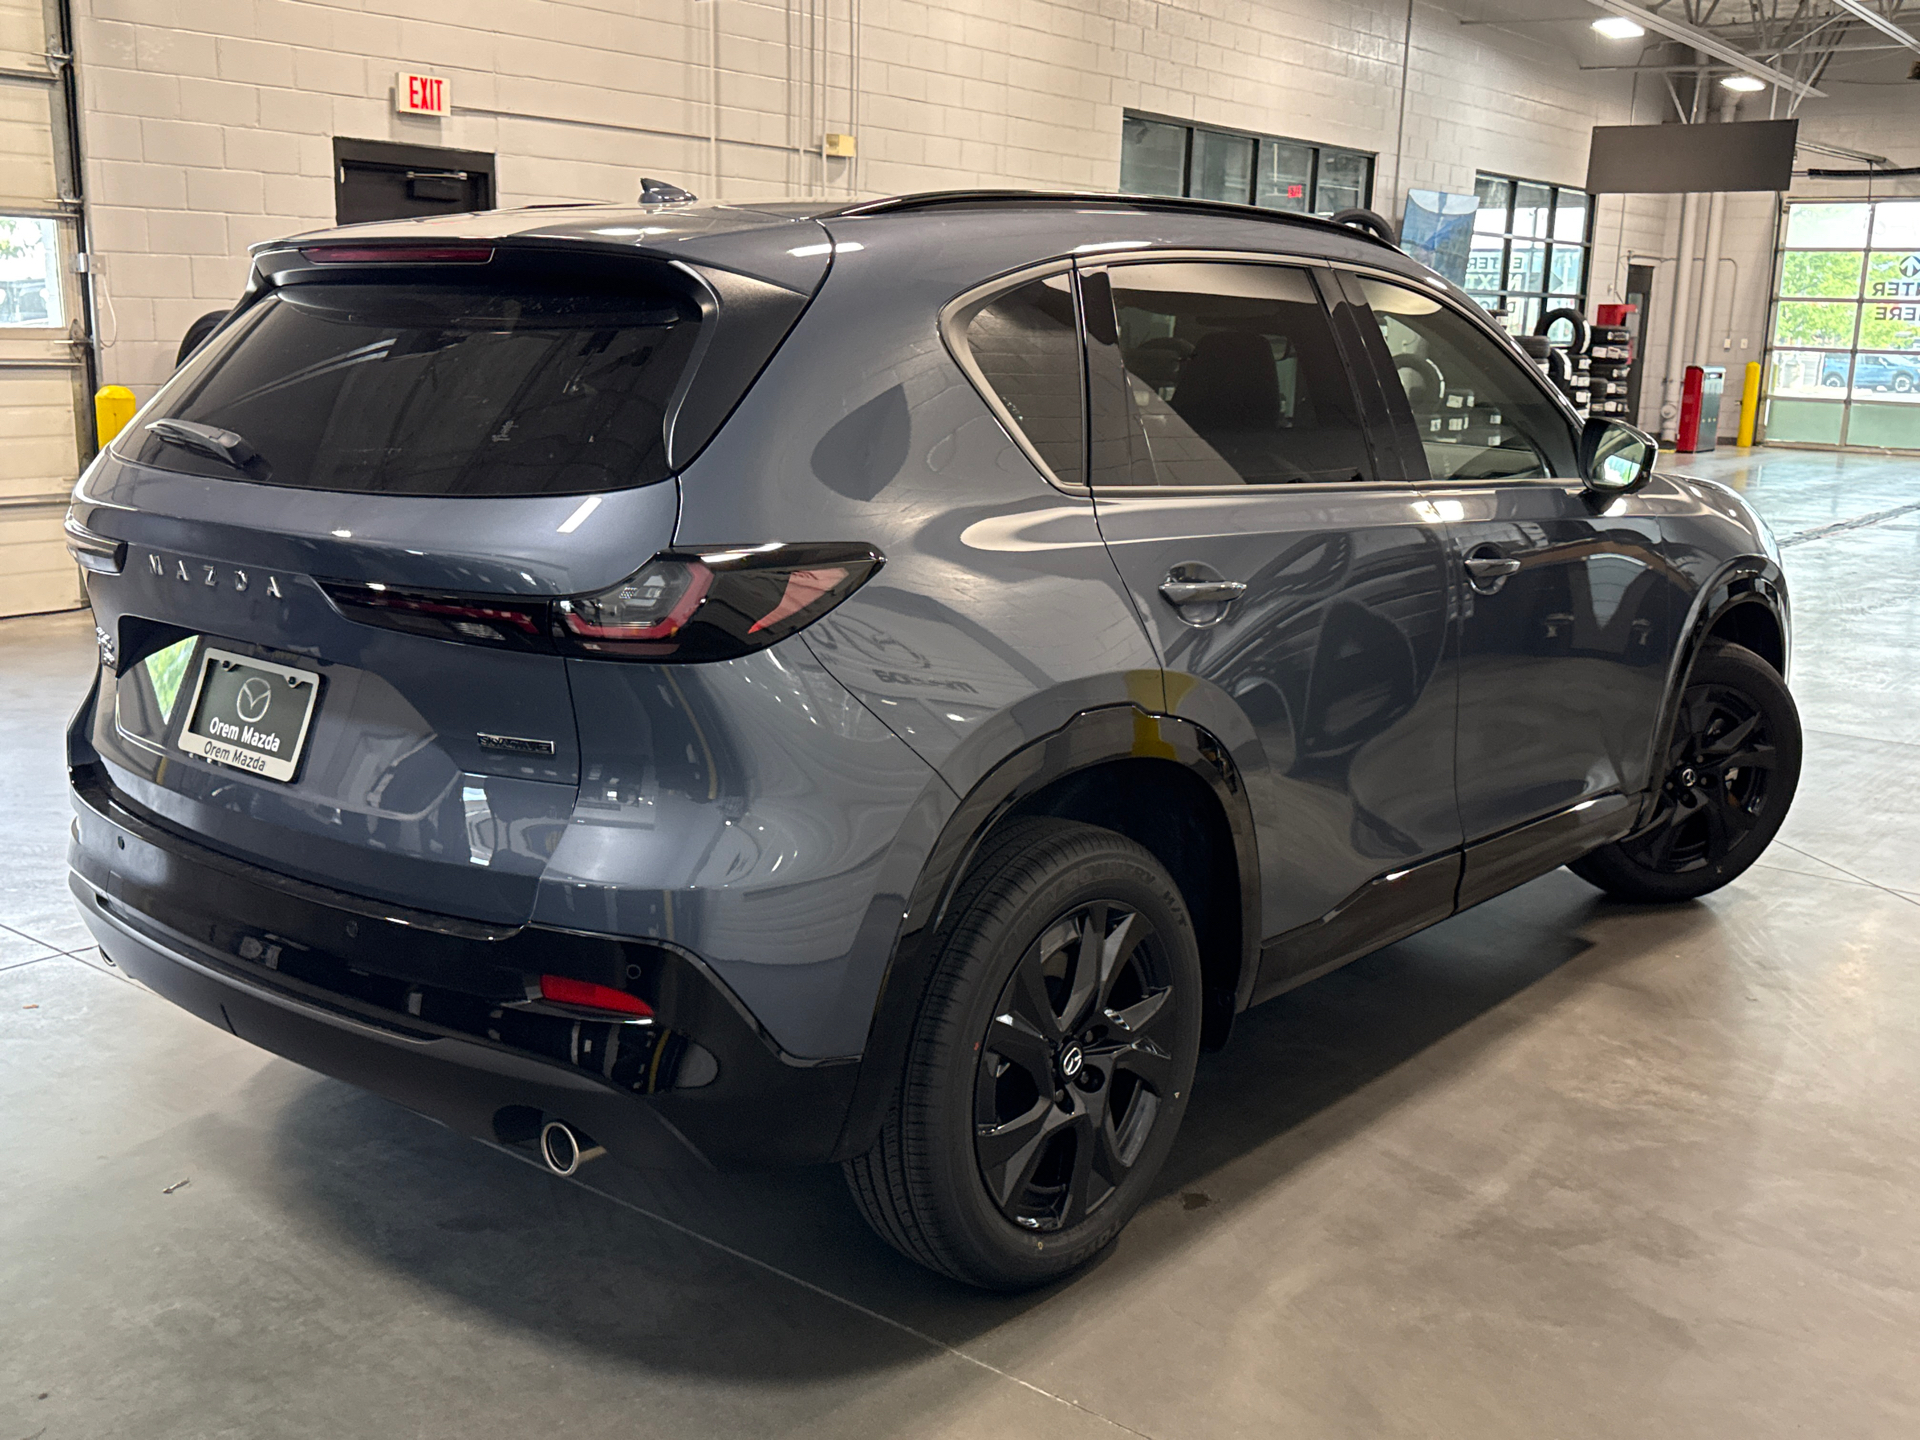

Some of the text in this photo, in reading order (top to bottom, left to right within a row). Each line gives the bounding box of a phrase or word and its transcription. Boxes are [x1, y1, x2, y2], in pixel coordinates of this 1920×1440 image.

[409, 76, 443, 112] EXIT
[149, 554, 282, 598] MAZDA
[209, 717, 280, 752] Orem Mazda
[204, 741, 266, 772] Orem Mazda
